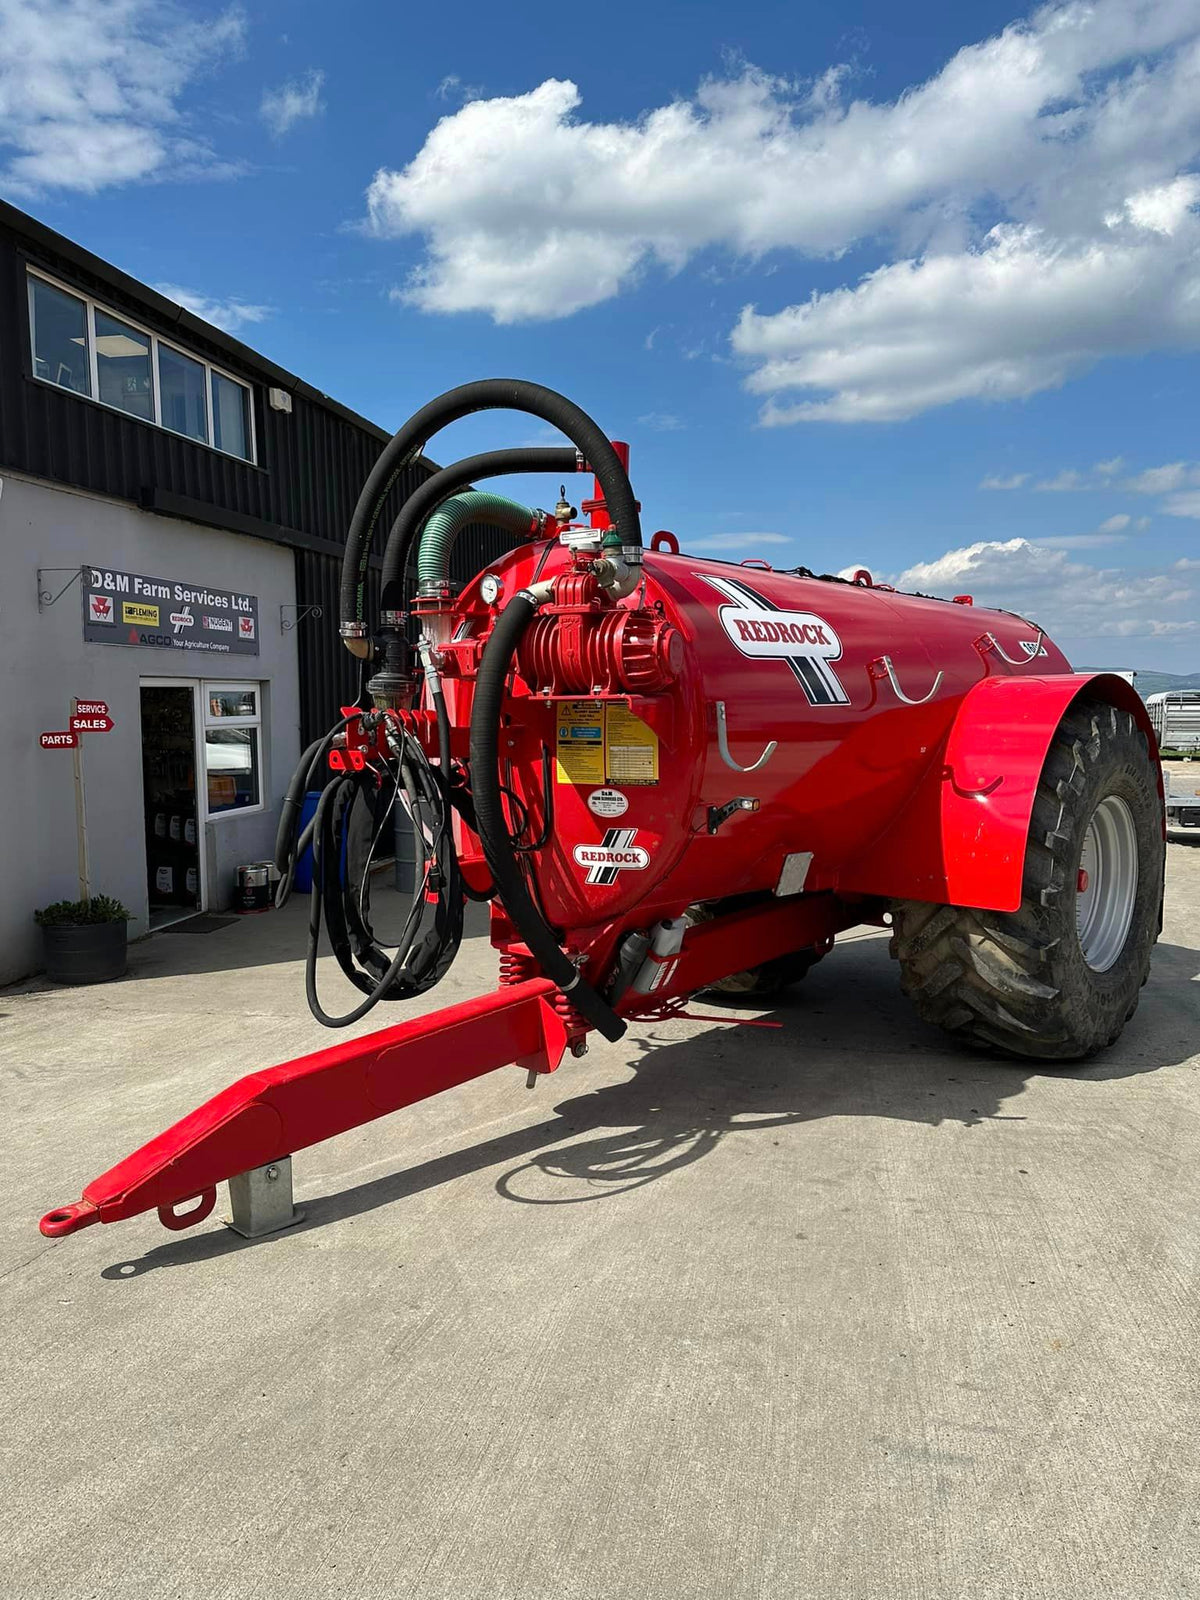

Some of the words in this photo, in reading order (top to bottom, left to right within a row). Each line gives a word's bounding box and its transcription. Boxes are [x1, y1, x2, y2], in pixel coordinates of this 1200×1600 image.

[91, 570, 130, 593] D&M
[134, 577, 171, 600] Farm
[174, 585, 229, 608] Services
[231, 595, 253, 612] Ltd.
[133, 607, 158, 618] FLEMING
[171, 615, 192, 624] REDROCK
[733, 619, 831, 645] REDROCK
[140, 634, 171, 646] AGCO
[172, 639, 183, 647] Your
[184, 640, 209, 649] Agriculture
[209, 641, 230, 652] Company
[77, 704, 106, 714] SERVICE
[73, 720, 107, 729] SALES
[41, 735, 73, 745] PARTS
[581, 850, 641, 864] REDROCK
